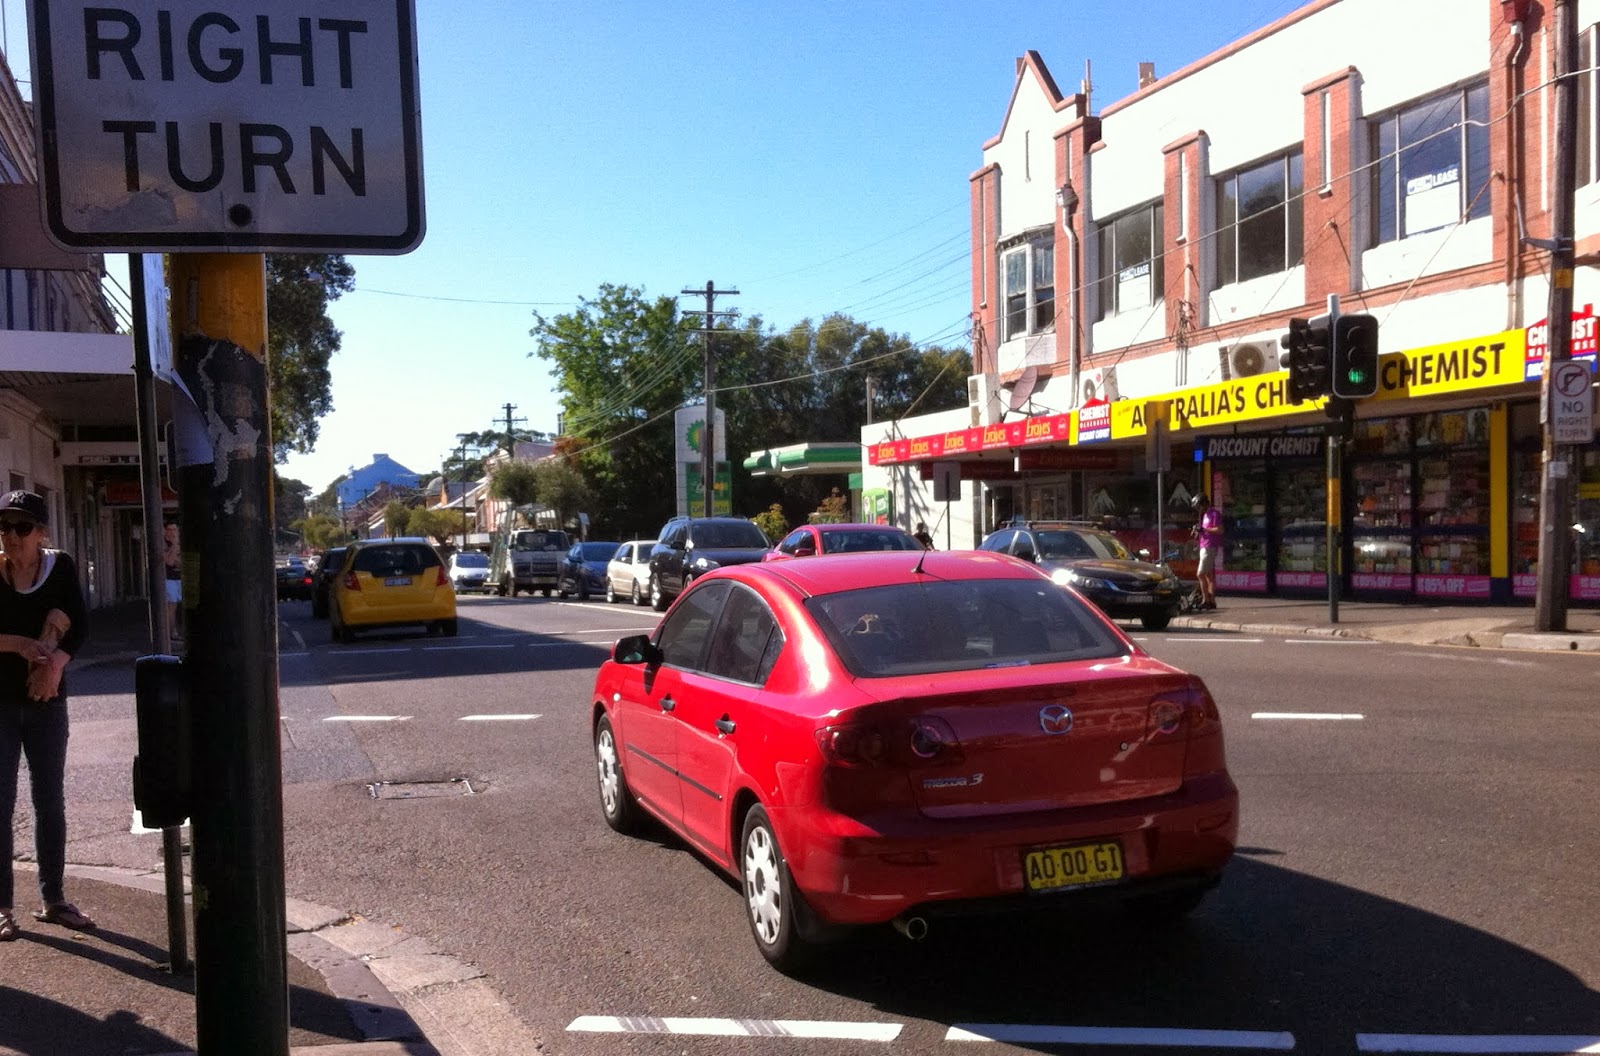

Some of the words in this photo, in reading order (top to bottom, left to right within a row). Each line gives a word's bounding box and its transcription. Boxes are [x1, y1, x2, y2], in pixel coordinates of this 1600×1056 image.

[83, 7, 368, 89] RIGHT
[102, 120, 367, 197] TURN
[1527, 317, 1597, 348] CHIST
[1381, 342, 1506, 391] CHEMIST
[1080, 403, 1109, 420] CHEMIST
[1561, 401, 1584, 413] NO
[1557, 416, 1589, 426] RIGHT
[1559, 428, 1588, 438] TURN
[1208, 438, 1268, 457] DISCOUNT
[1270, 437, 1320, 456] CHEMIST
[968, 773, 984, 785] 3
